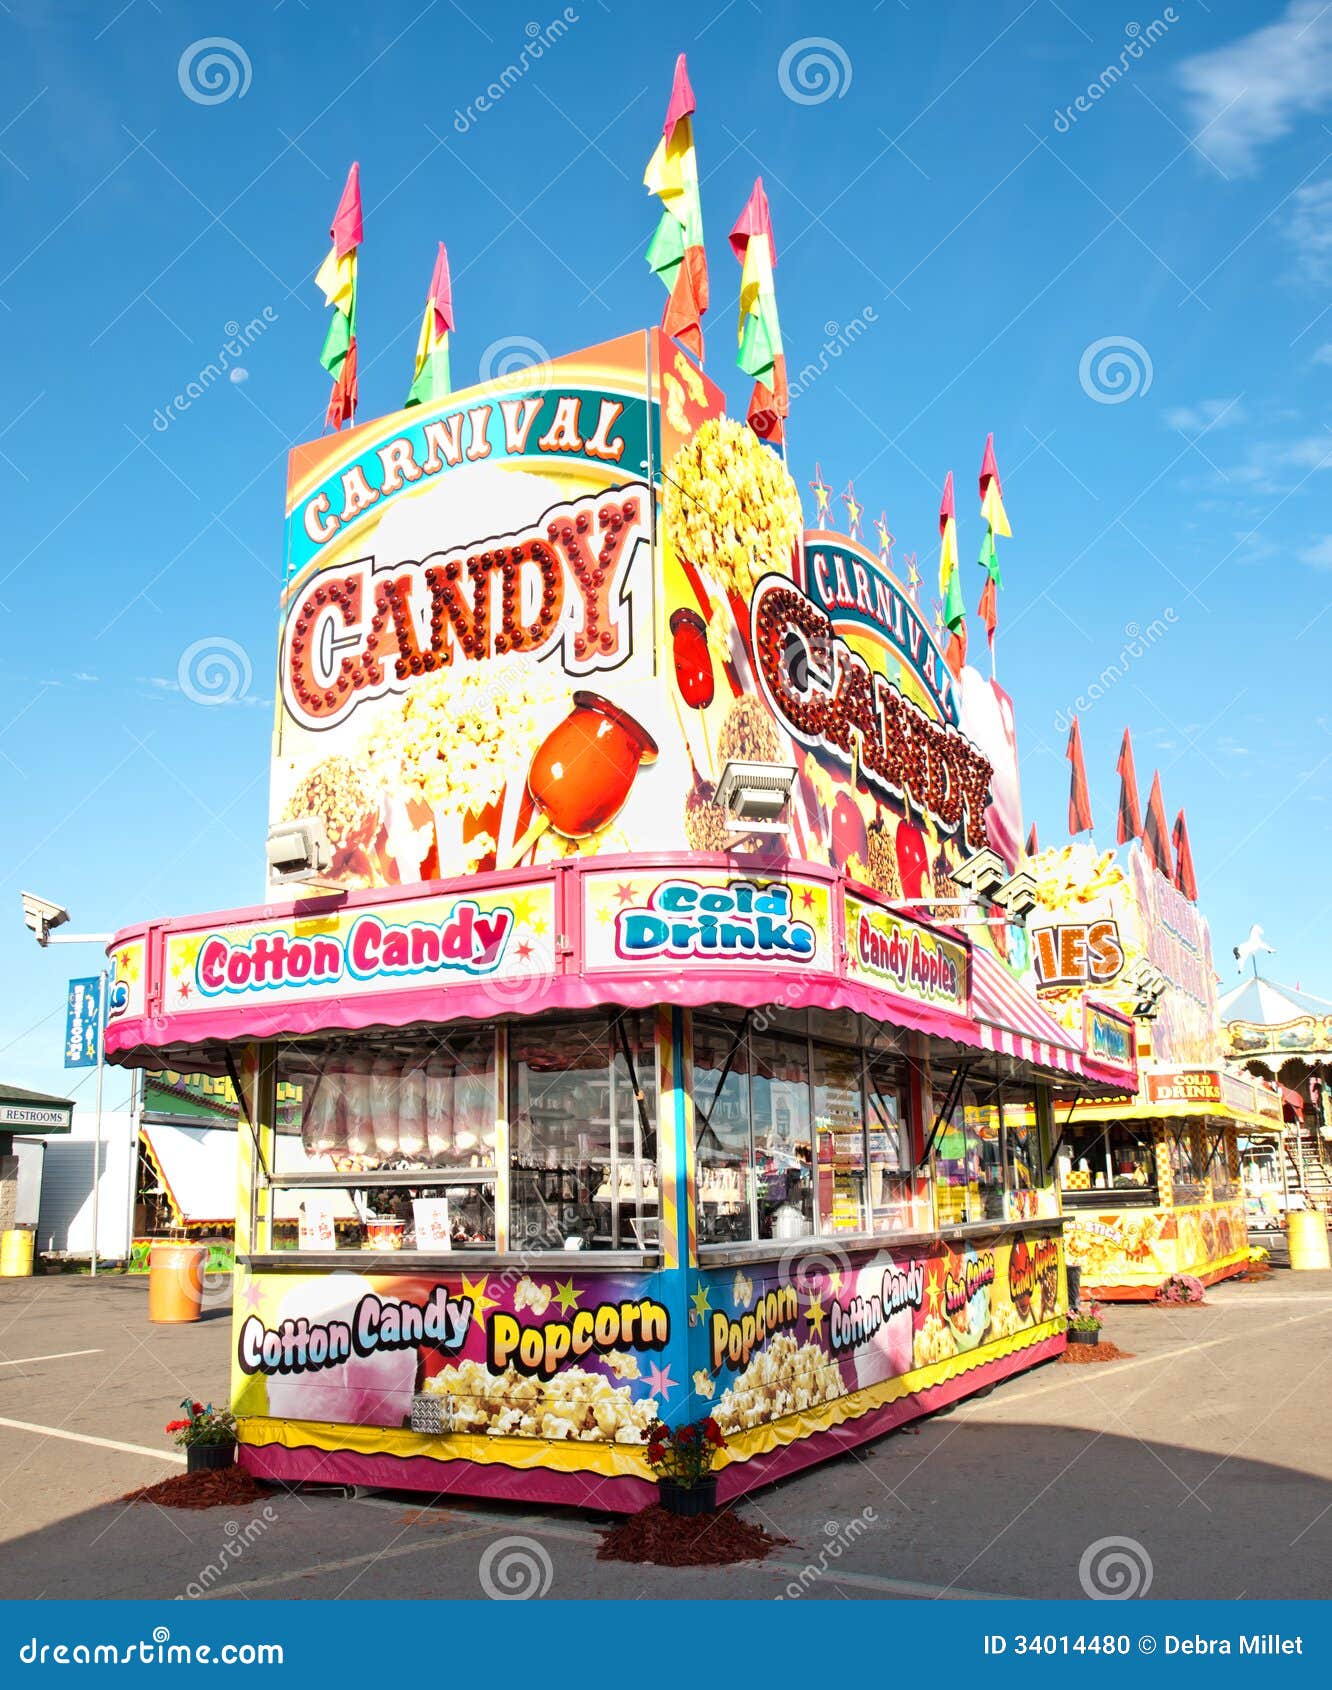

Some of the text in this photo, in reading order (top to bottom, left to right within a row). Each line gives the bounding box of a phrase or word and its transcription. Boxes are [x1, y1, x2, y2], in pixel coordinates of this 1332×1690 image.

[302, 396, 625, 544] CARNIVAL
[287, 495, 643, 720] CANDY
[812, 552, 954, 719] CARNIVAL
[754, 586, 995, 850] CANDY
[625, 914, 812, 953] Drinks
[659, 886, 787, 916] Cold
[202, 936, 340, 988] Cotton
[353, 907, 509, 968] Candy
[859, 915, 957, 994] Candy Apples
[1033, 921, 1124, 982] IES
[6, 1109, 63, 1122] RESTROOMS
[1157, 1086, 1220, 1099] DRINKS
[1173, 1075, 1211, 1086] COLD
[241, 1287, 473, 1371] Cotton Candy
[491, 1300, 669, 1375] Popcorn
[711, 1285, 798, 1372] Popcorn
[830, 1258, 925, 1349] Cotton Candy
